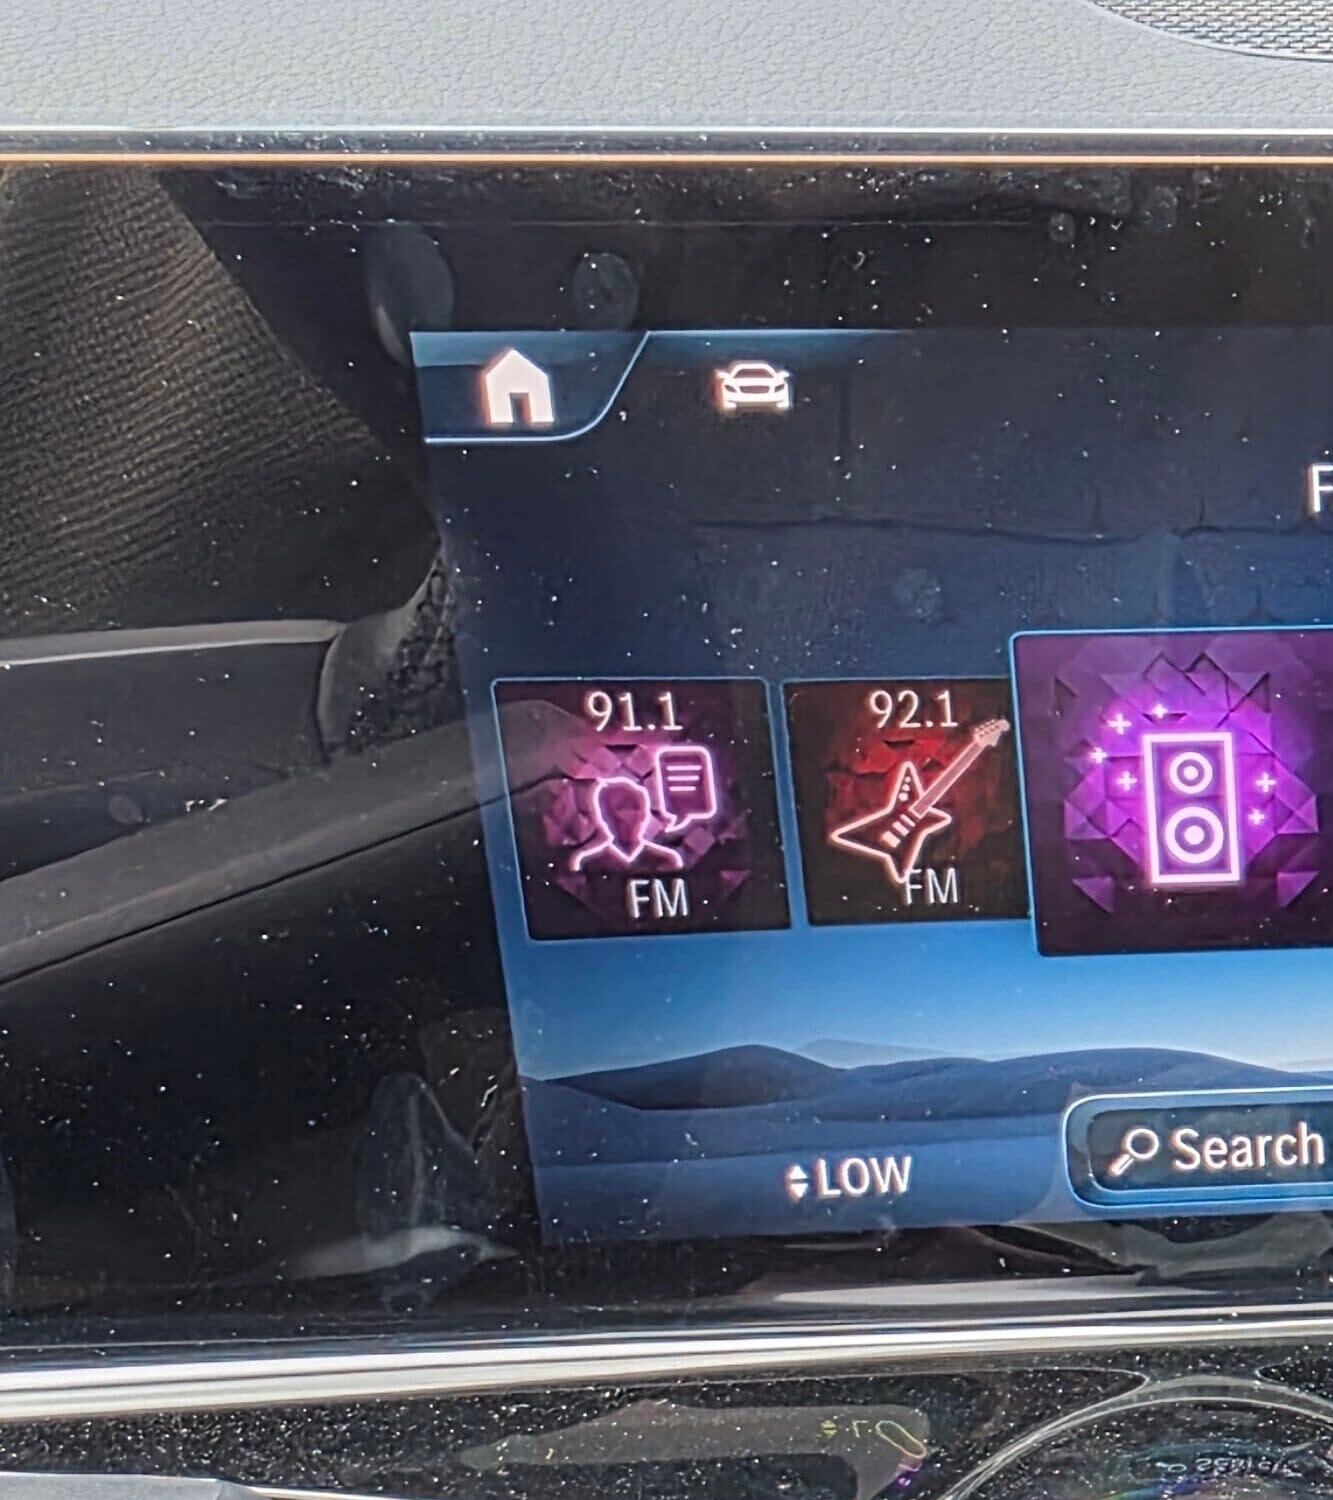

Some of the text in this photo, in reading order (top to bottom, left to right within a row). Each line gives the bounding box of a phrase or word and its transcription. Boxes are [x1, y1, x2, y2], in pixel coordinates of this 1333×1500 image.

[585, 691, 684, 732] 91.1
[868, 690, 959, 730] 92.1
[628, 880, 688, 918] FM
[902, 868, 959, 905] FM
[1171, 1121, 1326, 1171] Search
[815, 1155, 913, 1199] LOW
